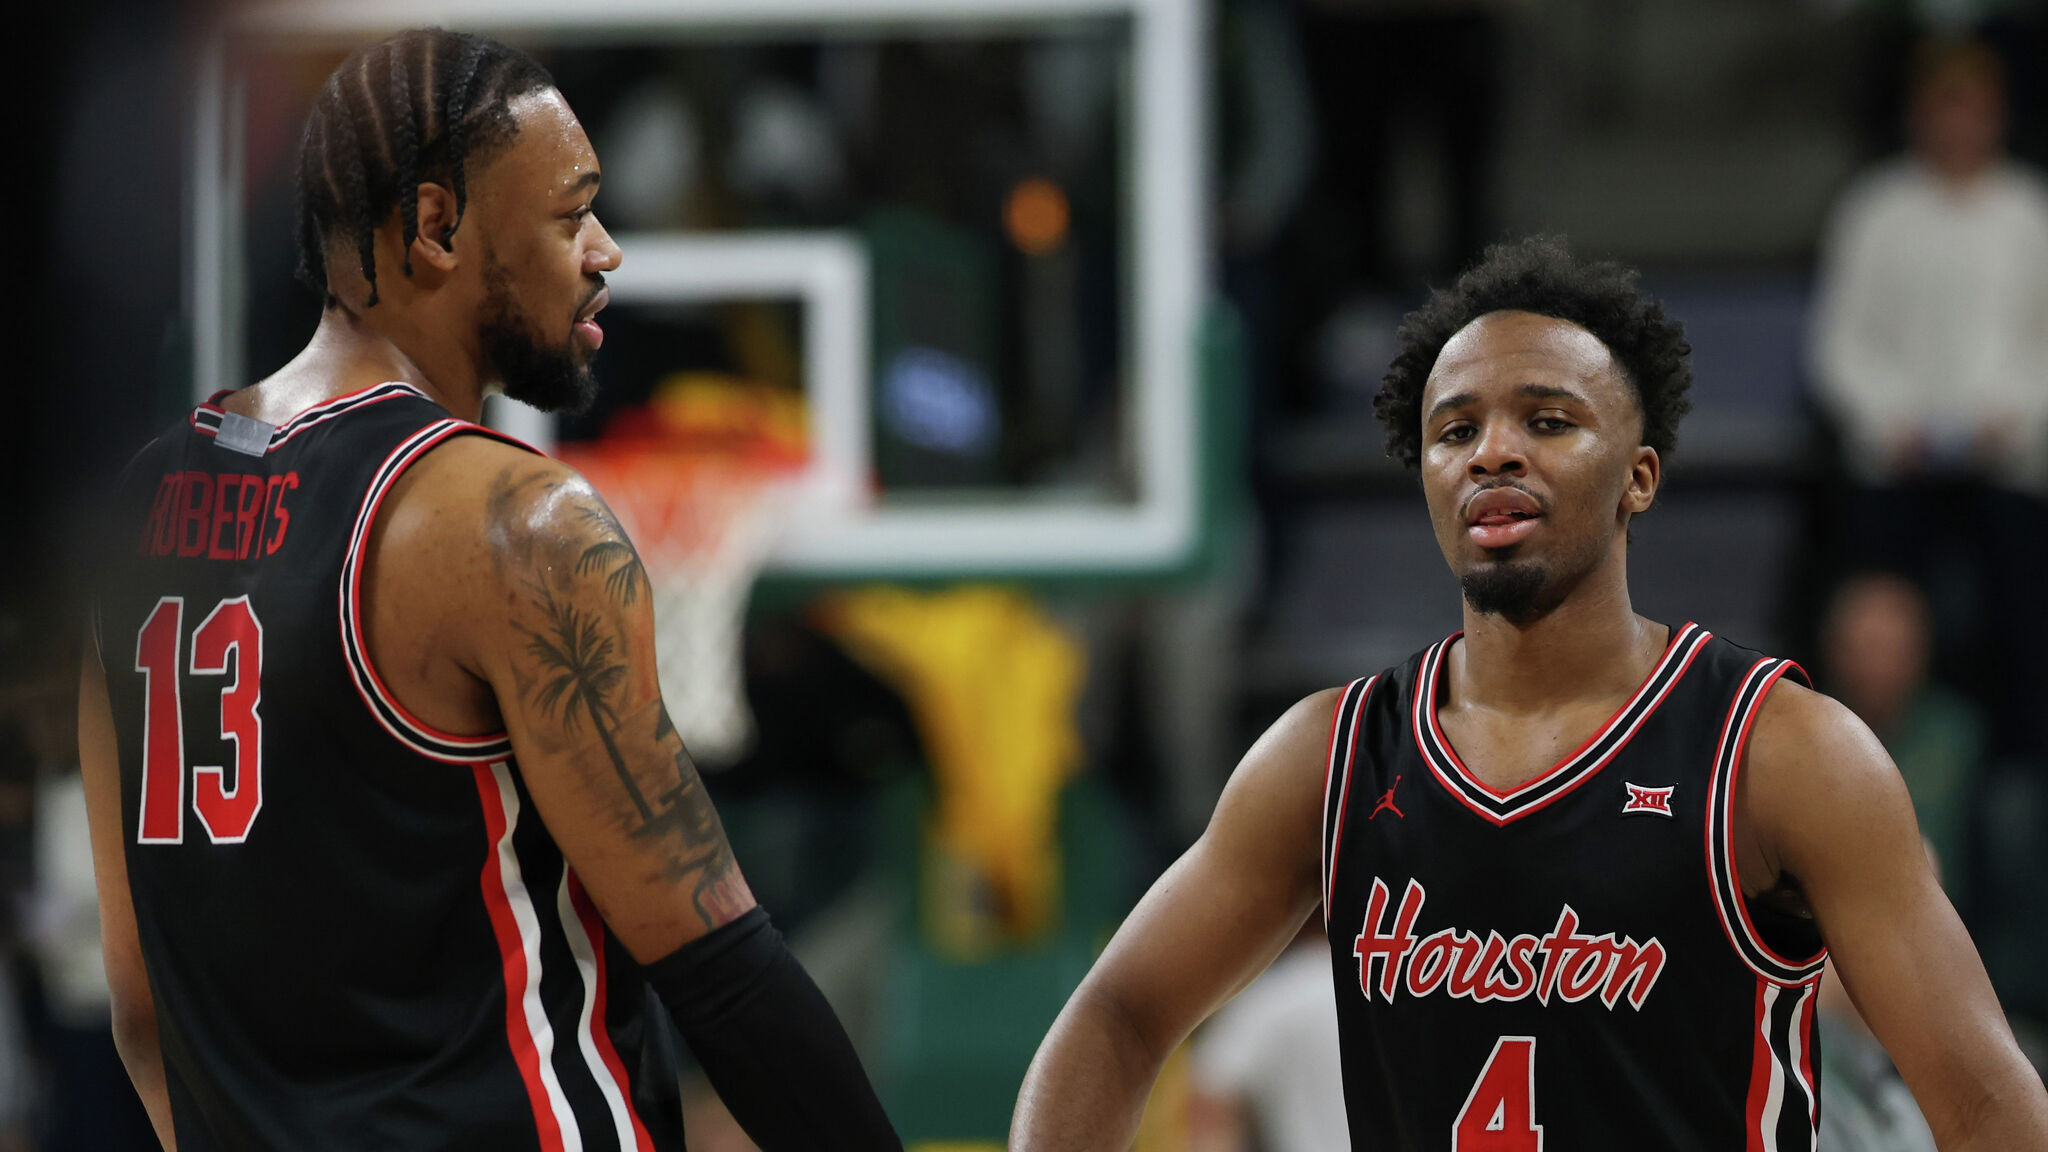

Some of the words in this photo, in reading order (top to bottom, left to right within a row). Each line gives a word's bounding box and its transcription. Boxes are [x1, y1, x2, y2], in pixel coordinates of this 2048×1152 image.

[137, 470, 299, 560] ROBERTS
[135, 594, 263, 844] 13
[1626, 785, 1673, 814] XII
[1353, 876, 1667, 1012] Houston
[1452, 1035, 1543, 1152] 4
